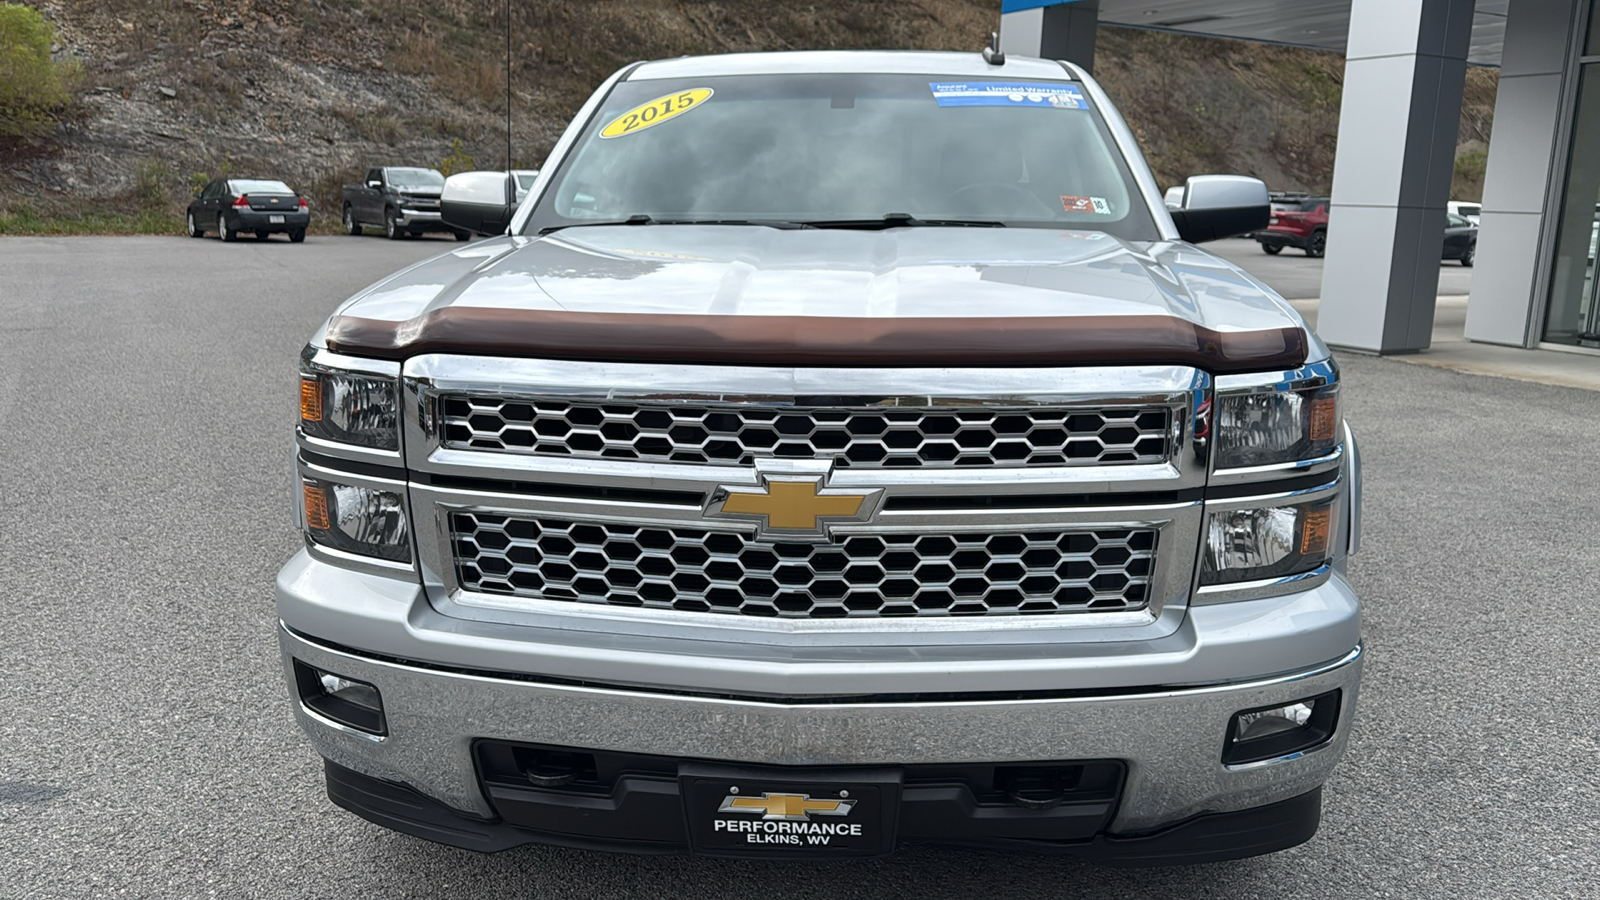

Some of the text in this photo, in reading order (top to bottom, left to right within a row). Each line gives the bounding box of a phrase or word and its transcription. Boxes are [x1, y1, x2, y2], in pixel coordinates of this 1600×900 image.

[1025, 86, 1073, 96] Warranty
[622, 92, 694, 132] 2015
[714, 820, 862, 836] PERFORMANCE
[747, 834, 830, 846] ELKINS, WV
